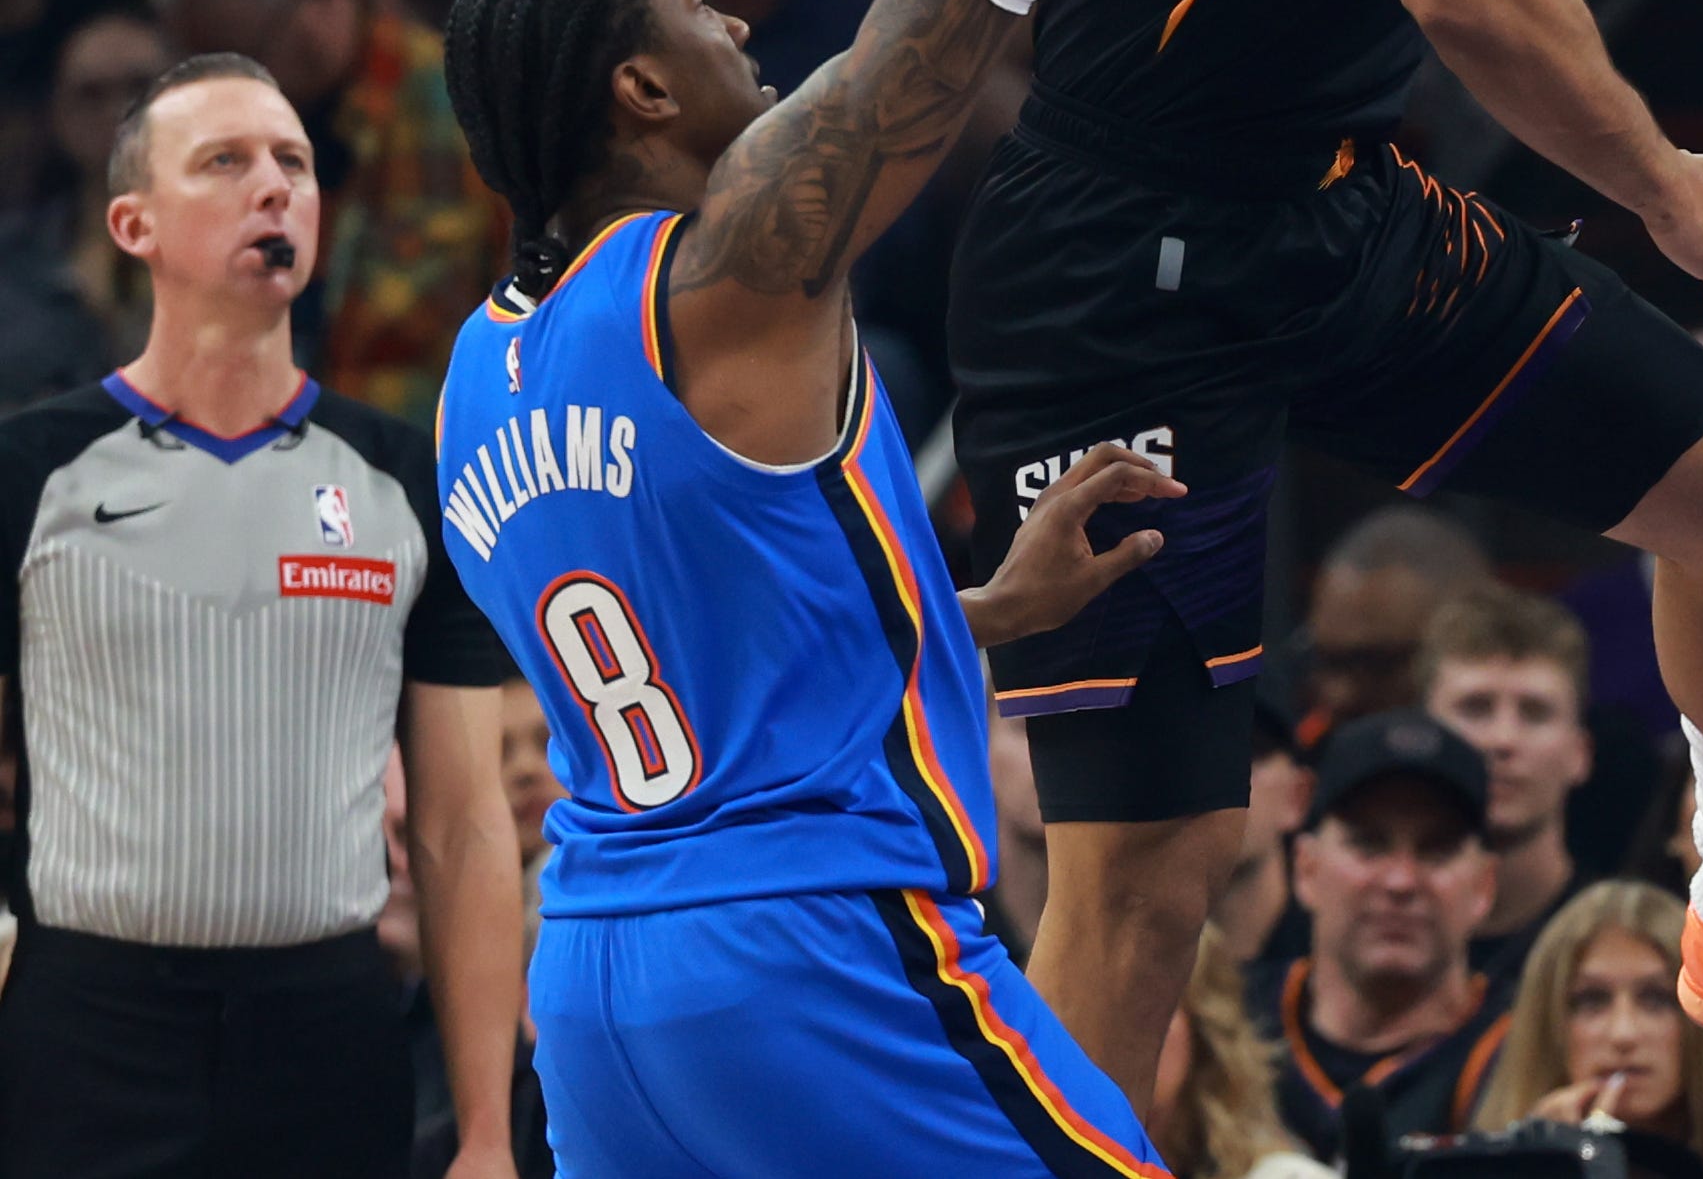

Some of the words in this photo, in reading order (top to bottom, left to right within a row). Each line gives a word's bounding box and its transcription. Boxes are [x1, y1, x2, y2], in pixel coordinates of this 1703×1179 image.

[445, 404, 636, 562] WILLIAMS
[1015, 425, 1174, 522] SS
[282, 561, 393, 596] Emirates
[536, 569, 702, 814] 8
